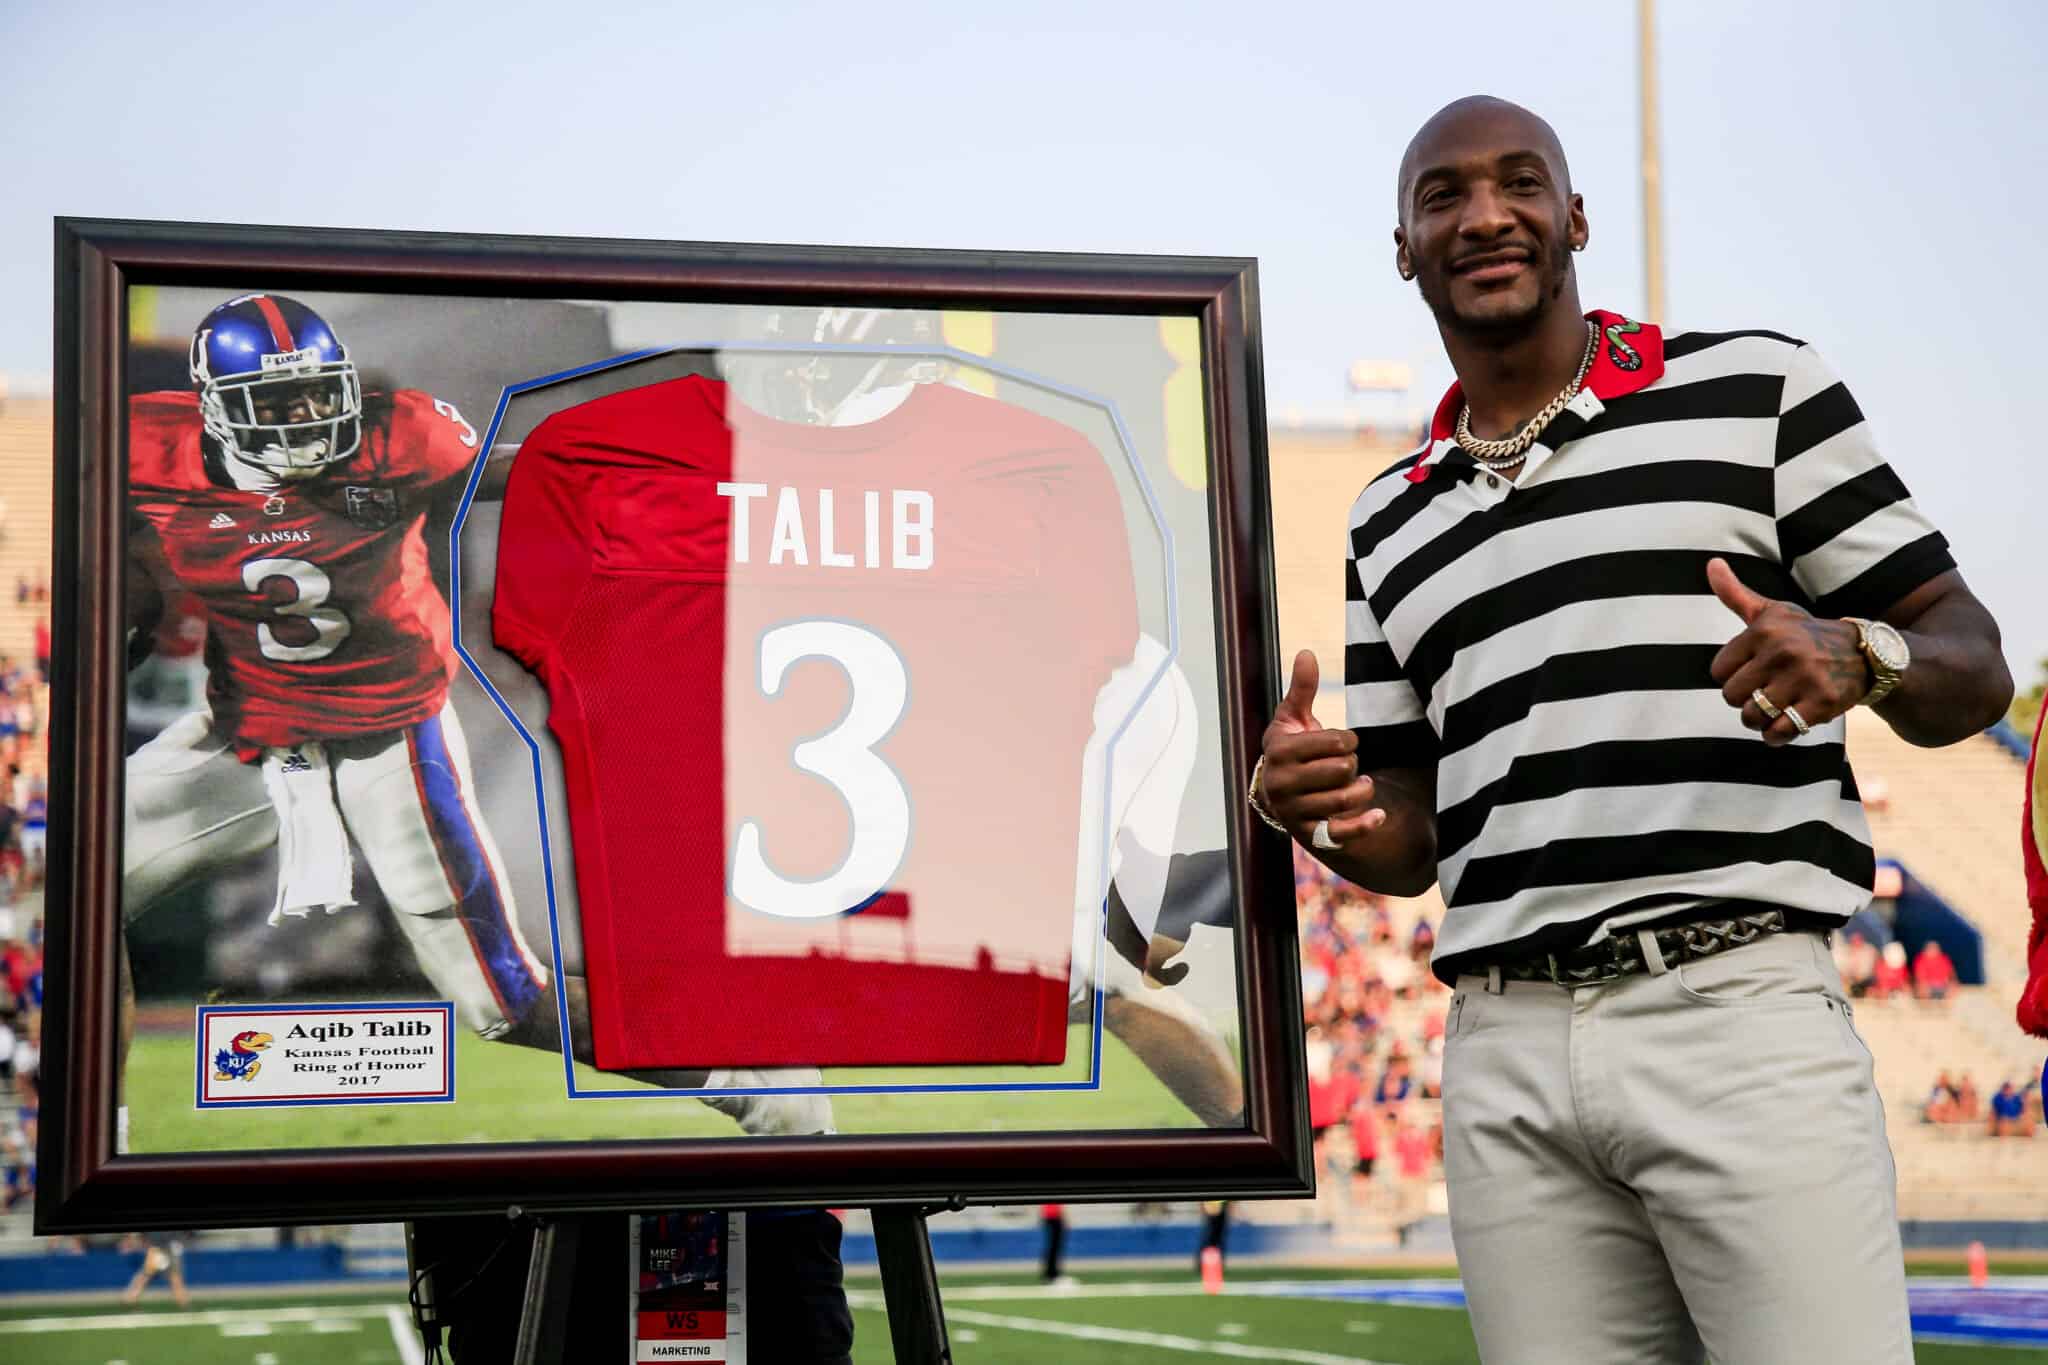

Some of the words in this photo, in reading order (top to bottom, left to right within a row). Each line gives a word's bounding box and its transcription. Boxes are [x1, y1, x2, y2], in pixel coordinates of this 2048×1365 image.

[716, 481, 935, 570] TALIB
[248, 530, 312, 544] KANSAS
[241, 557, 350, 662] 3
[730, 618, 911, 920] 3
[287, 1021, 354, 1042] Aqib
[363, 1020, 432, 1038] Talib
[284, 1048, 352, 1058] Kansas
[358, 1045, 434, 1057] Football
[293, 1062, 337, 1074] Ring
[343, 1061, 362, 1071] of
[367, 1060, 426, 1071] Honor
[337, 1075, 381, 1086] 2017
[649, 1248, 678, 1260] MIKE
[649, 1260, 672, 1272] LEE
[665, 1312, 700, 1331] WS
[651, 1345, 712, 1357] MARKETING
